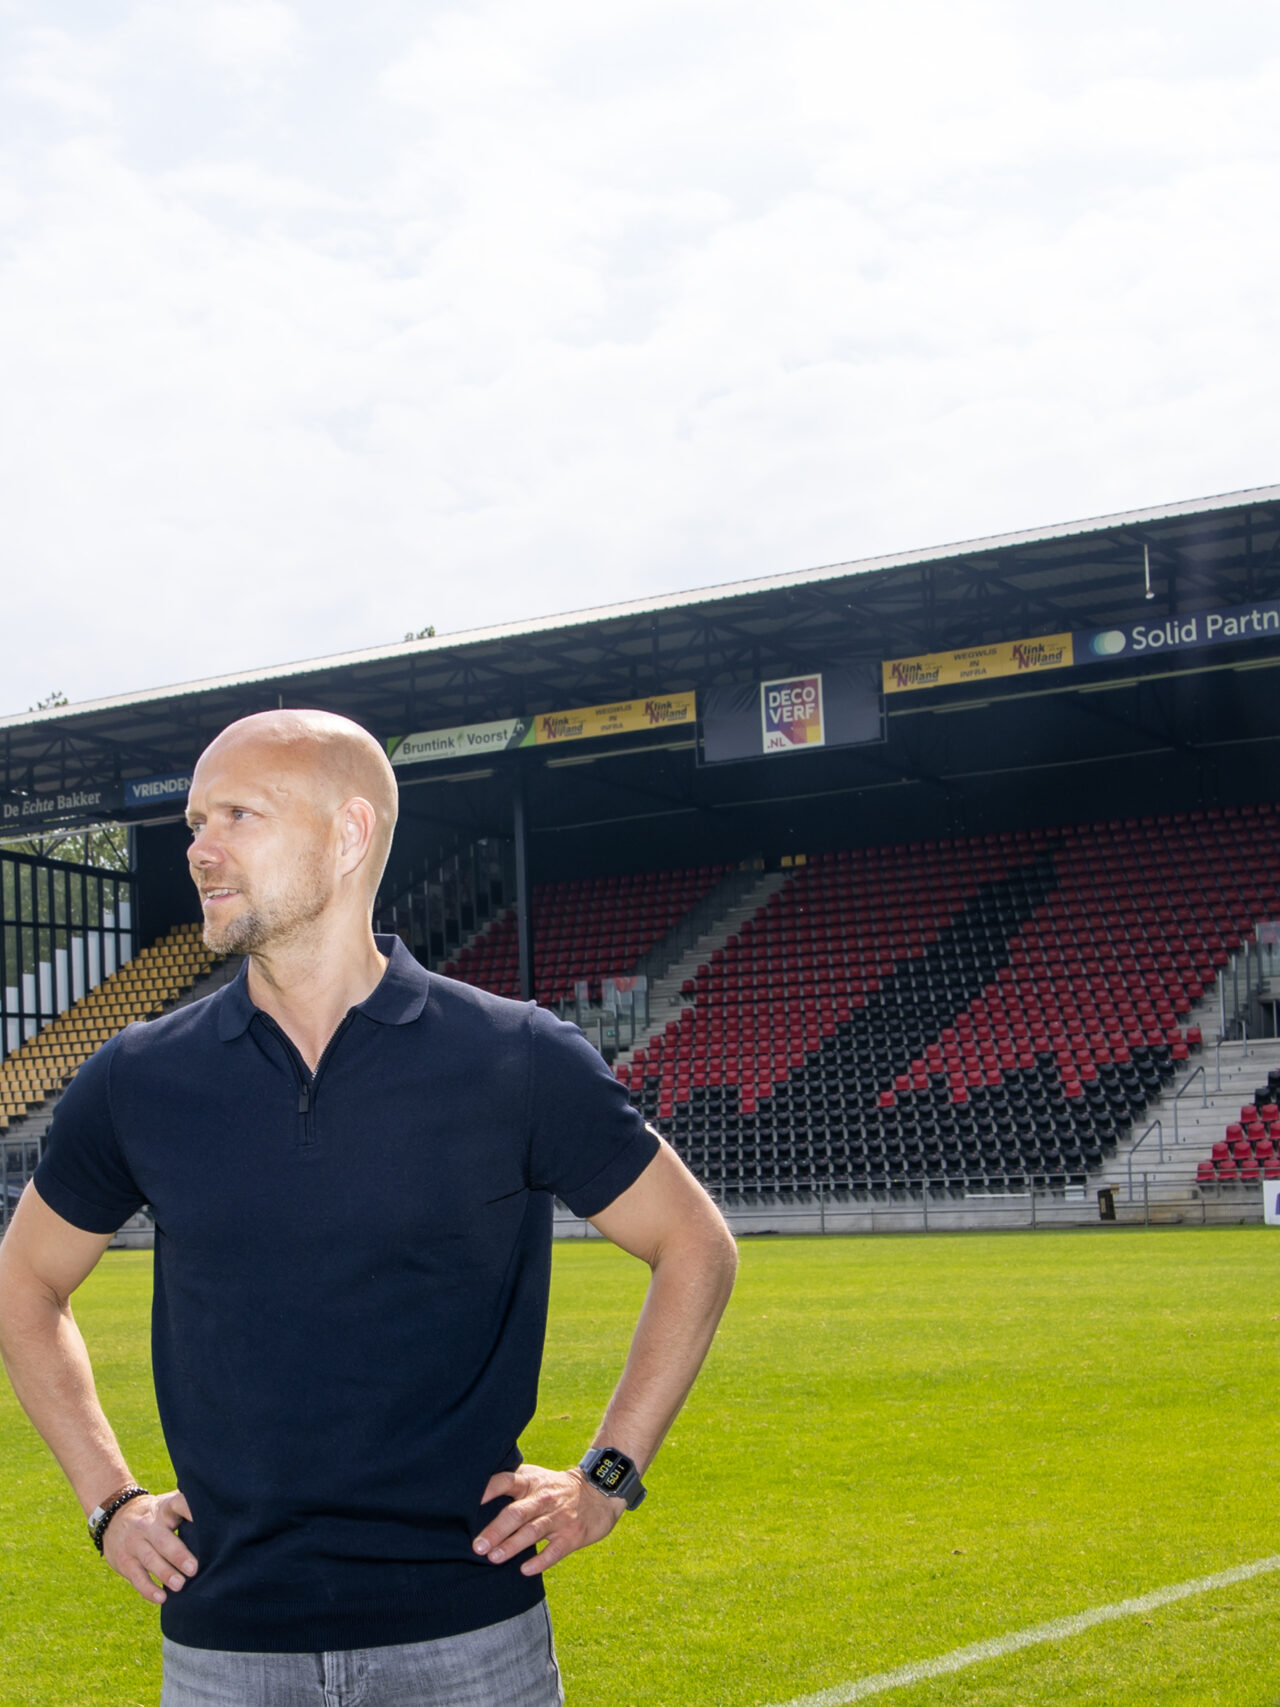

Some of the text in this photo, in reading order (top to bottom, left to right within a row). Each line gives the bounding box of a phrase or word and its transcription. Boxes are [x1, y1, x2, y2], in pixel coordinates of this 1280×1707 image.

[1132, 610, 1280, 650] Solid Partn
[1012, 644, 1045, 658] Klink
[1018, 650, 1063, 669] Nijland
[891, 662, 922, 676] Klink
[896, 669, 939, 688] Nijland
[769, 686, 816, 707] DECO
[645, 701, 673, 714] Klink
[649, 706, 688, 724] Nijland
[769, 703, 815, 724] VERF
[542, 716, 569, 729] Klink
[402, 729, 508, 755] Bruntink Voorst
[767, 737, 787, 749] .NL
[3, 791, 102, 818] De Echte Bakker
